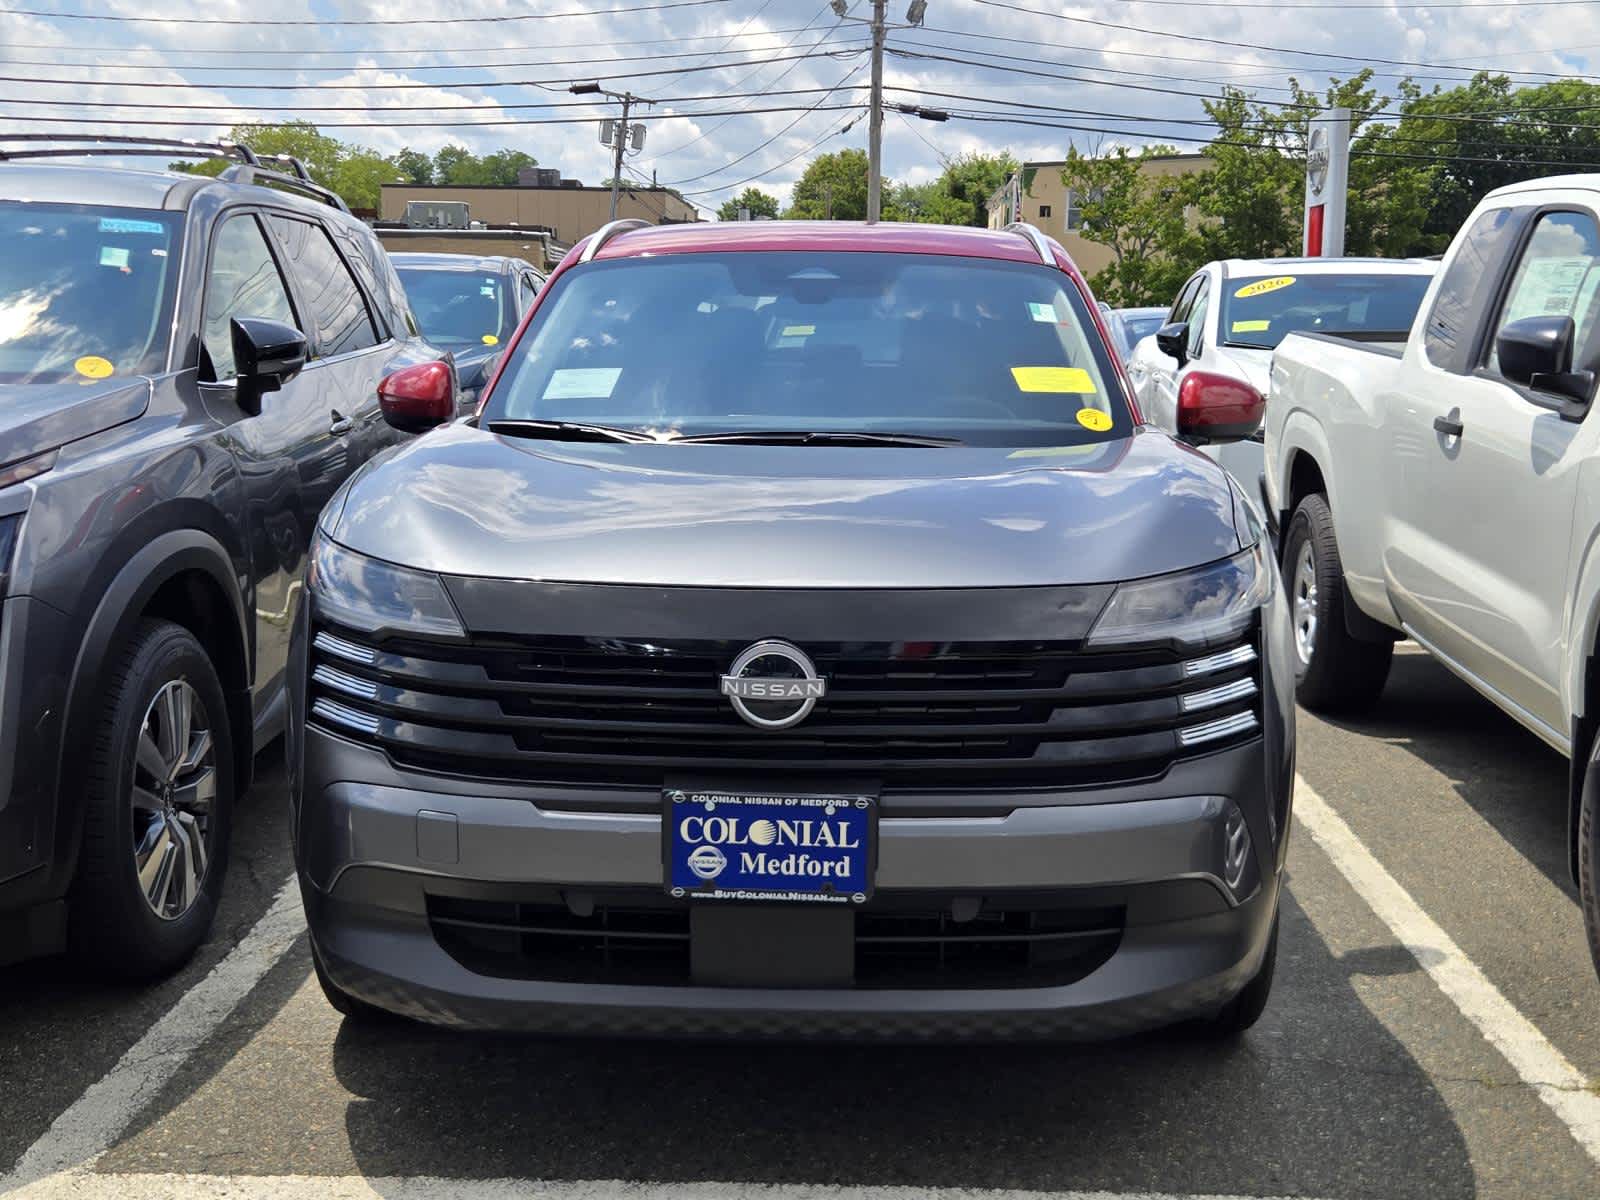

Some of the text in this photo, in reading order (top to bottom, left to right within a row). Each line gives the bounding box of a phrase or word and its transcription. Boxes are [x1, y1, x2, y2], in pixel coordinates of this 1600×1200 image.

[1248, 280, 1284, 294] 2026
[724, 680, 822, 697] NISSAN
[691, 795, 849, 807] COLONIAL NISSAN OF MEDFORD
[680, 816, 859, 848] COLONIAL
[739, 852, 850, 877] Medford
